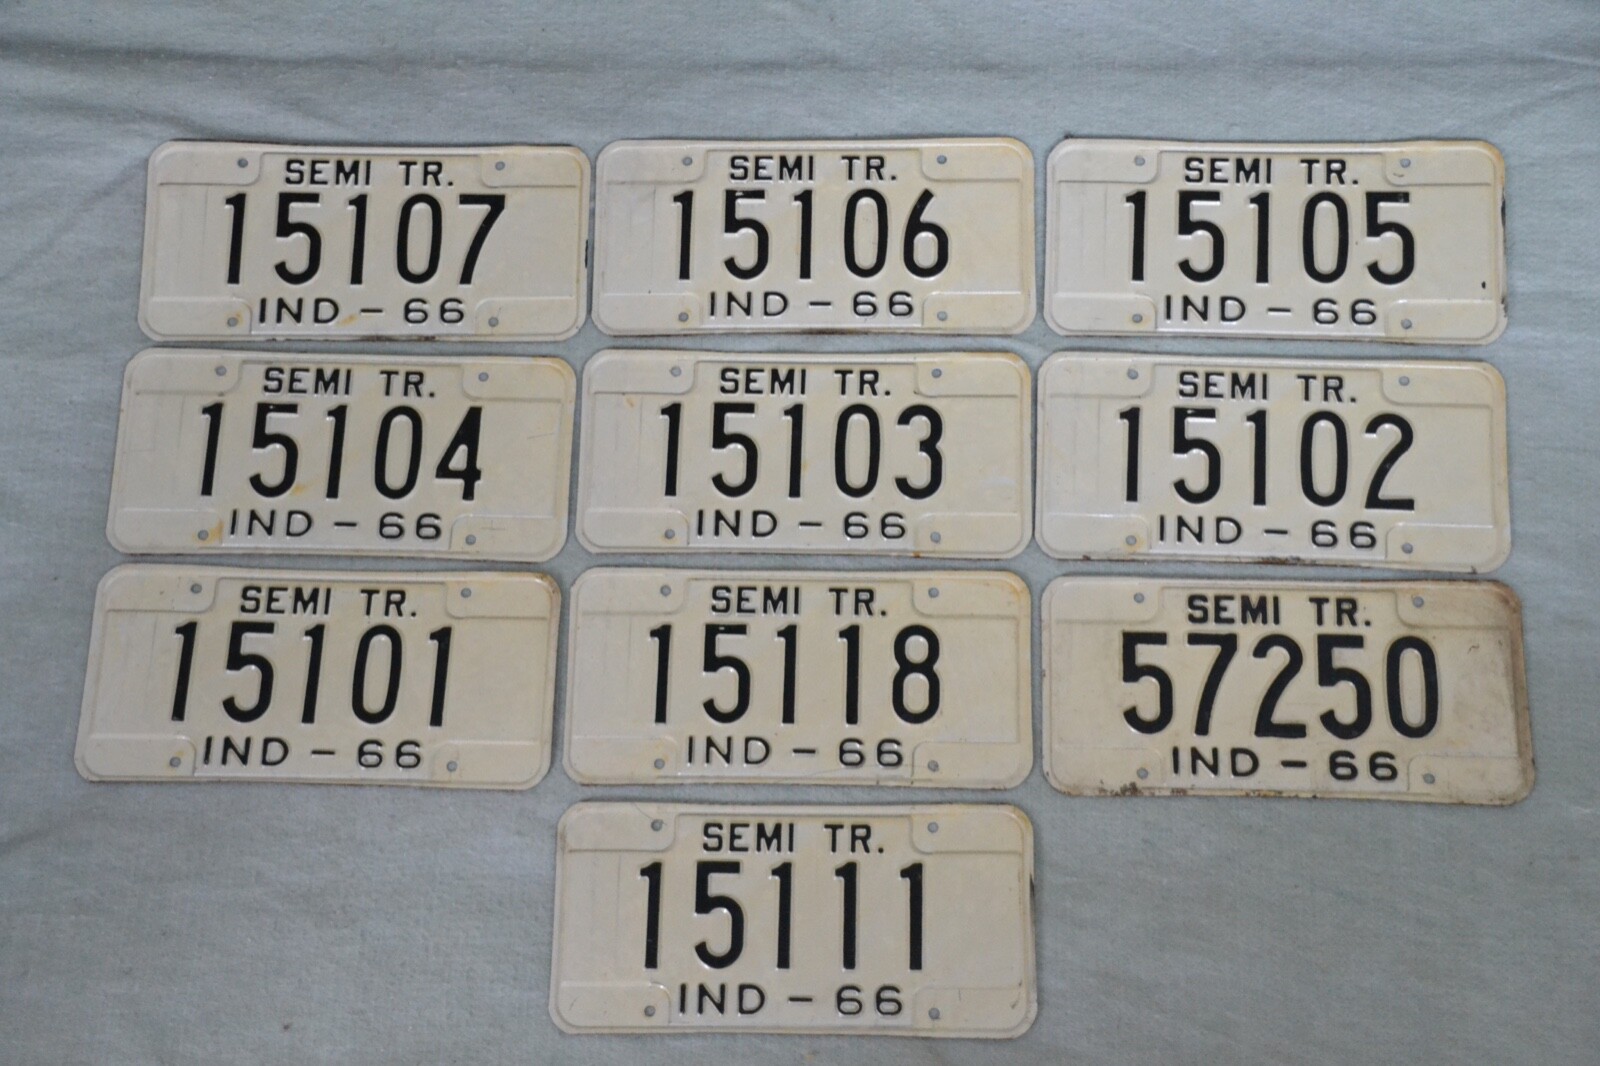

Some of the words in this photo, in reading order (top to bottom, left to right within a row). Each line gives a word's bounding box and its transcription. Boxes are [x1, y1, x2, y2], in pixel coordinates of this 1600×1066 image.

[284, 157, 372, 186] SEMI
[398, 159, 454, 187] TR.
[729, 154, 815, 181] SEMI
[840, 154, 897, 181] TR.
[1184, 155, 1272, 185] SEMI
[1299, 157, 1359, 186] TR.
[225, 191, 506, 286] 15107
[672, 187, 949, 281] 15106
[1125, 189, 1415, 286] 15105
[258, 297, 340, 324] IND
[403, 297, 465, 325] 66
[709, 290, 790, 317] IND
[852, 290, 914, 317] 66
[1165, 294, 1247, 323] IND
[1312, 297, 1377, 326] 66
[262, 366, 352, 396] SEMI
[379, 369, 435, 398] TR.
[719, 366, 807, 396] SEMI
[833, 368, 891, 397] TR.
[1178, 370, 1268, 401] SEMI
[1296, 374, 1357, 403] TR.
[200, 401, 483, 502] 15104
[660, 401, 943, 500] 15103
[1119, 406, 1415, 511] 15102
[229, 508, 314, 538] IND
[378, 511, 442, 541] 66
[696, 508, 778, 538] IND
[843, 511, 906, 540] 66
[1159, 514, 1243, 545] IND
[1310, 519, 1377, 550] 66
[239, 584, 332, 616] SEMI
[359, 588, 417, 618] TR.
[710, 585, 800, 615] SEMI
[828, 587, 887, 617] TR.
[1187, 593, 1281, 626] SEMI
[1308, 596, 1372, 627] TR.
[170, 620, 453, 728] 15101
[649, 622, 941, 726] 15118
[1121, 630, 1439, 741] 57250
[203, 735, 290, 767] IND
[357, 738, 422, 770] 66
[687, 735, 772, 765] IND
[838, 737, 904, 769] 66
[1171, 745, 1260, 778] IND
[1328, 749, 1399, 782] 66
[702, 821, 795, 853] SEMI
[823, 823, 884, 854] TR.
[639, 860, 924, 971] 15111
[679, 982, 766, 1015] IND
[835, 984, 903, 1017] 66
